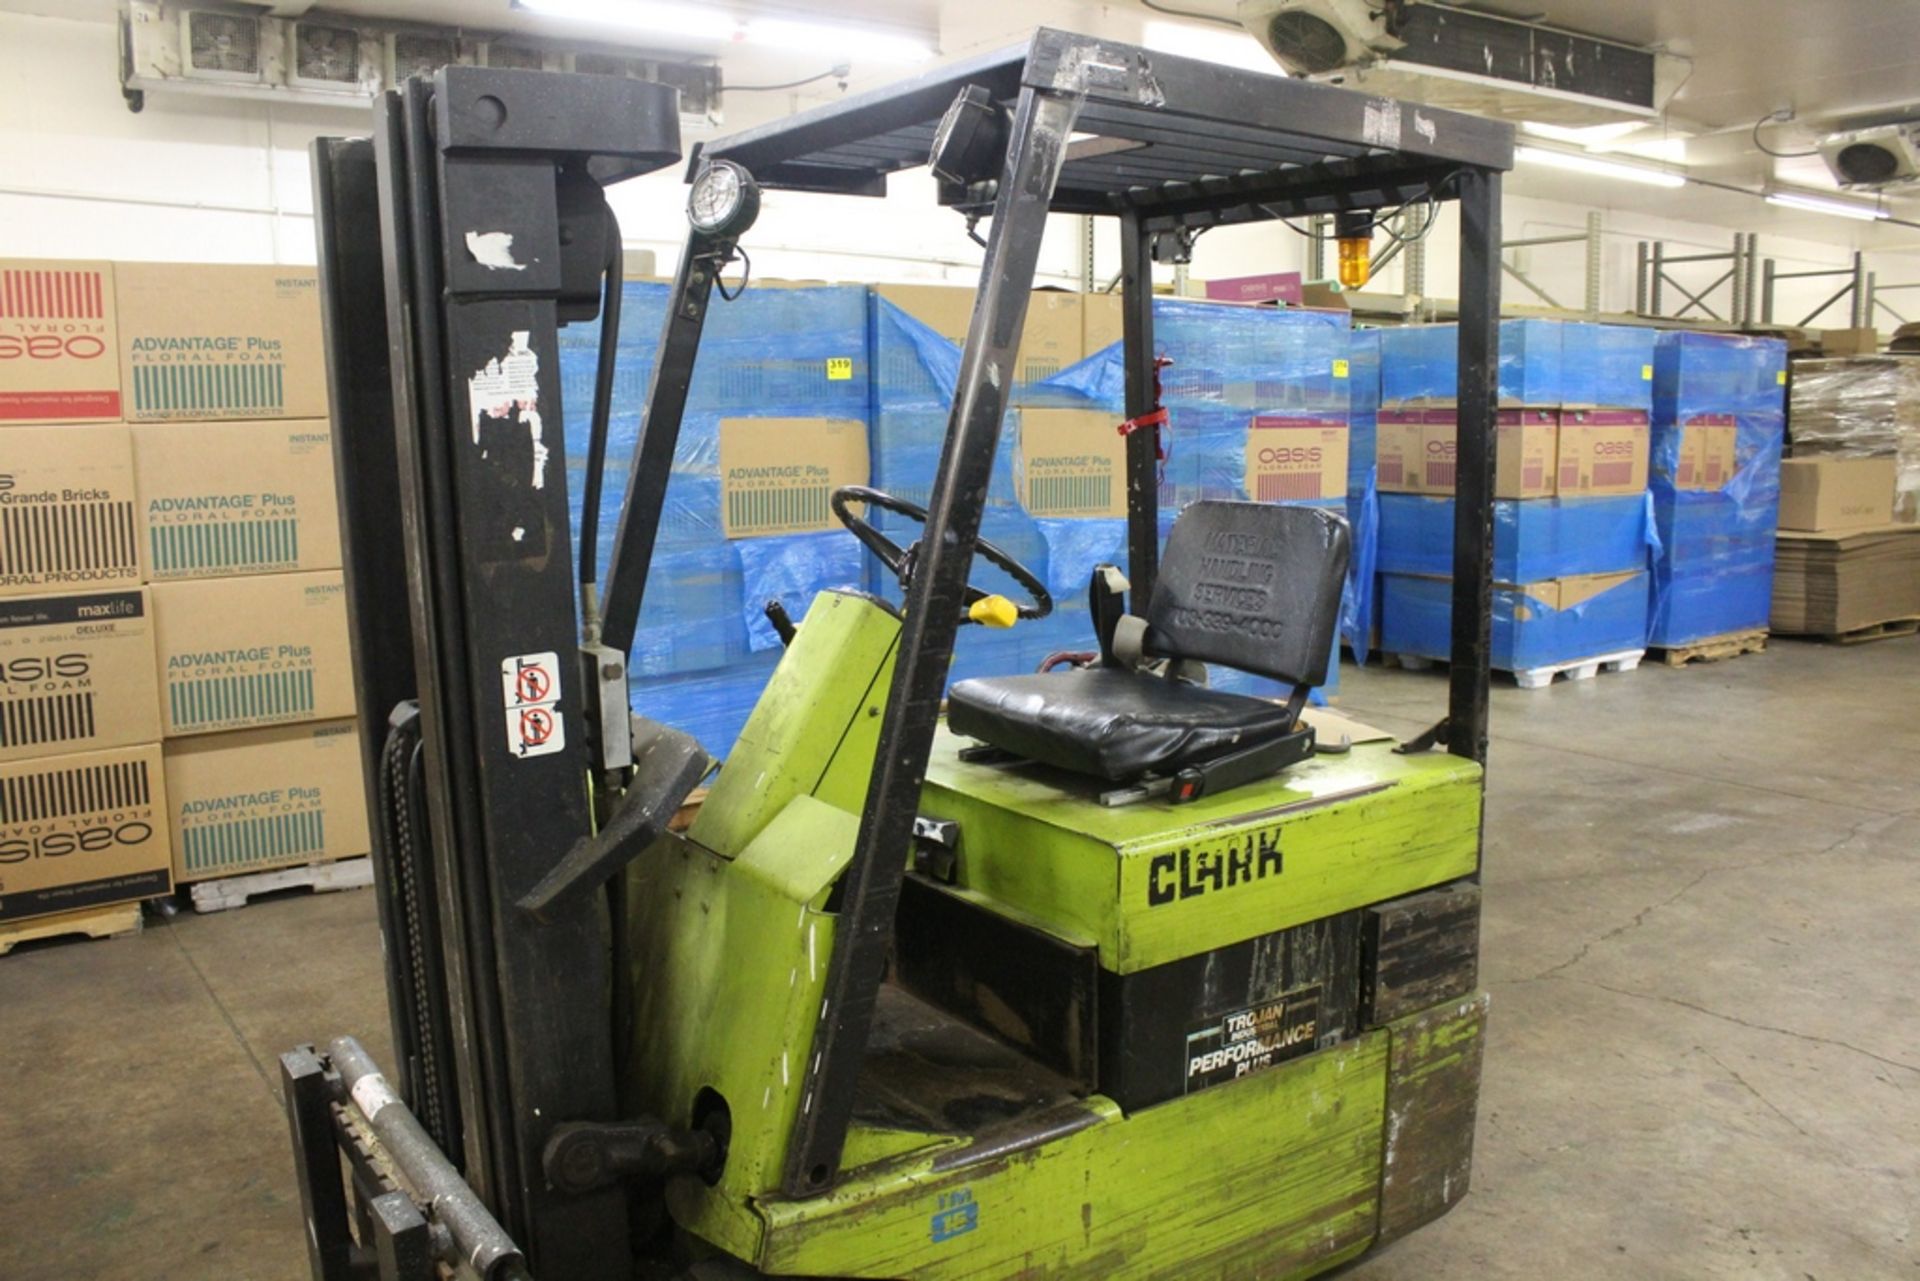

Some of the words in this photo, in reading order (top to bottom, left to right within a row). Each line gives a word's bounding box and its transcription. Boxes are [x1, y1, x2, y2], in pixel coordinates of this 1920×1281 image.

[16, 324, 104, 333] FLORAL
[132, 337, 243, 351] ADVANTAGE
[247, 337, 281, 350] Plus
[132, 353, 215, 361] FLORAL
[226, 352, 282, 360] FOAM
[728, 465, 803, 478] ADVANTAGE
[806, 465, 829, 475] Plus
[728, 480, 784, 488] FLORAL
[791, 478, 829, 486] FOAM
[0, 491, 57, 504] Grande
[62, 489, 111, 501] Bricks
[149, 495, 257, 512] ADVANTAGE
[262, 493, 295, 506] Plus
[149, 511, 230, 522] FLORAL
[241, 508, 296, 518] FOAM
[45, 568, 137, 583] PRODUCTS
[1194, 582, 1268, 611] SERVICES
[78, 601, 135, 618] maxlife
[76, 624, 116, 635] DELUXE
[168, 648, 273, 668] ADVANTAGE
[278, 645, 311, 658] Plus
[168, 666, 248, 678] FLORAL
[258, 659, 312, 670] FOAM
[30, 678, 91, 692] FOAM
[181, 790, 283, 815] ADVANTAGE
[288, 787, 320, 800] Plus
[69, 809, 151, 828] FLORAL
[181, 809, 258, 825] FLORAL
[270, 799, 321, 812] FOAM
[1149, 828, 1283, 907] CLARK
[1227, 1003, 1284, 1032] TROJAN
[1188, 1021, 1316, 1077] PERFORMANCE
